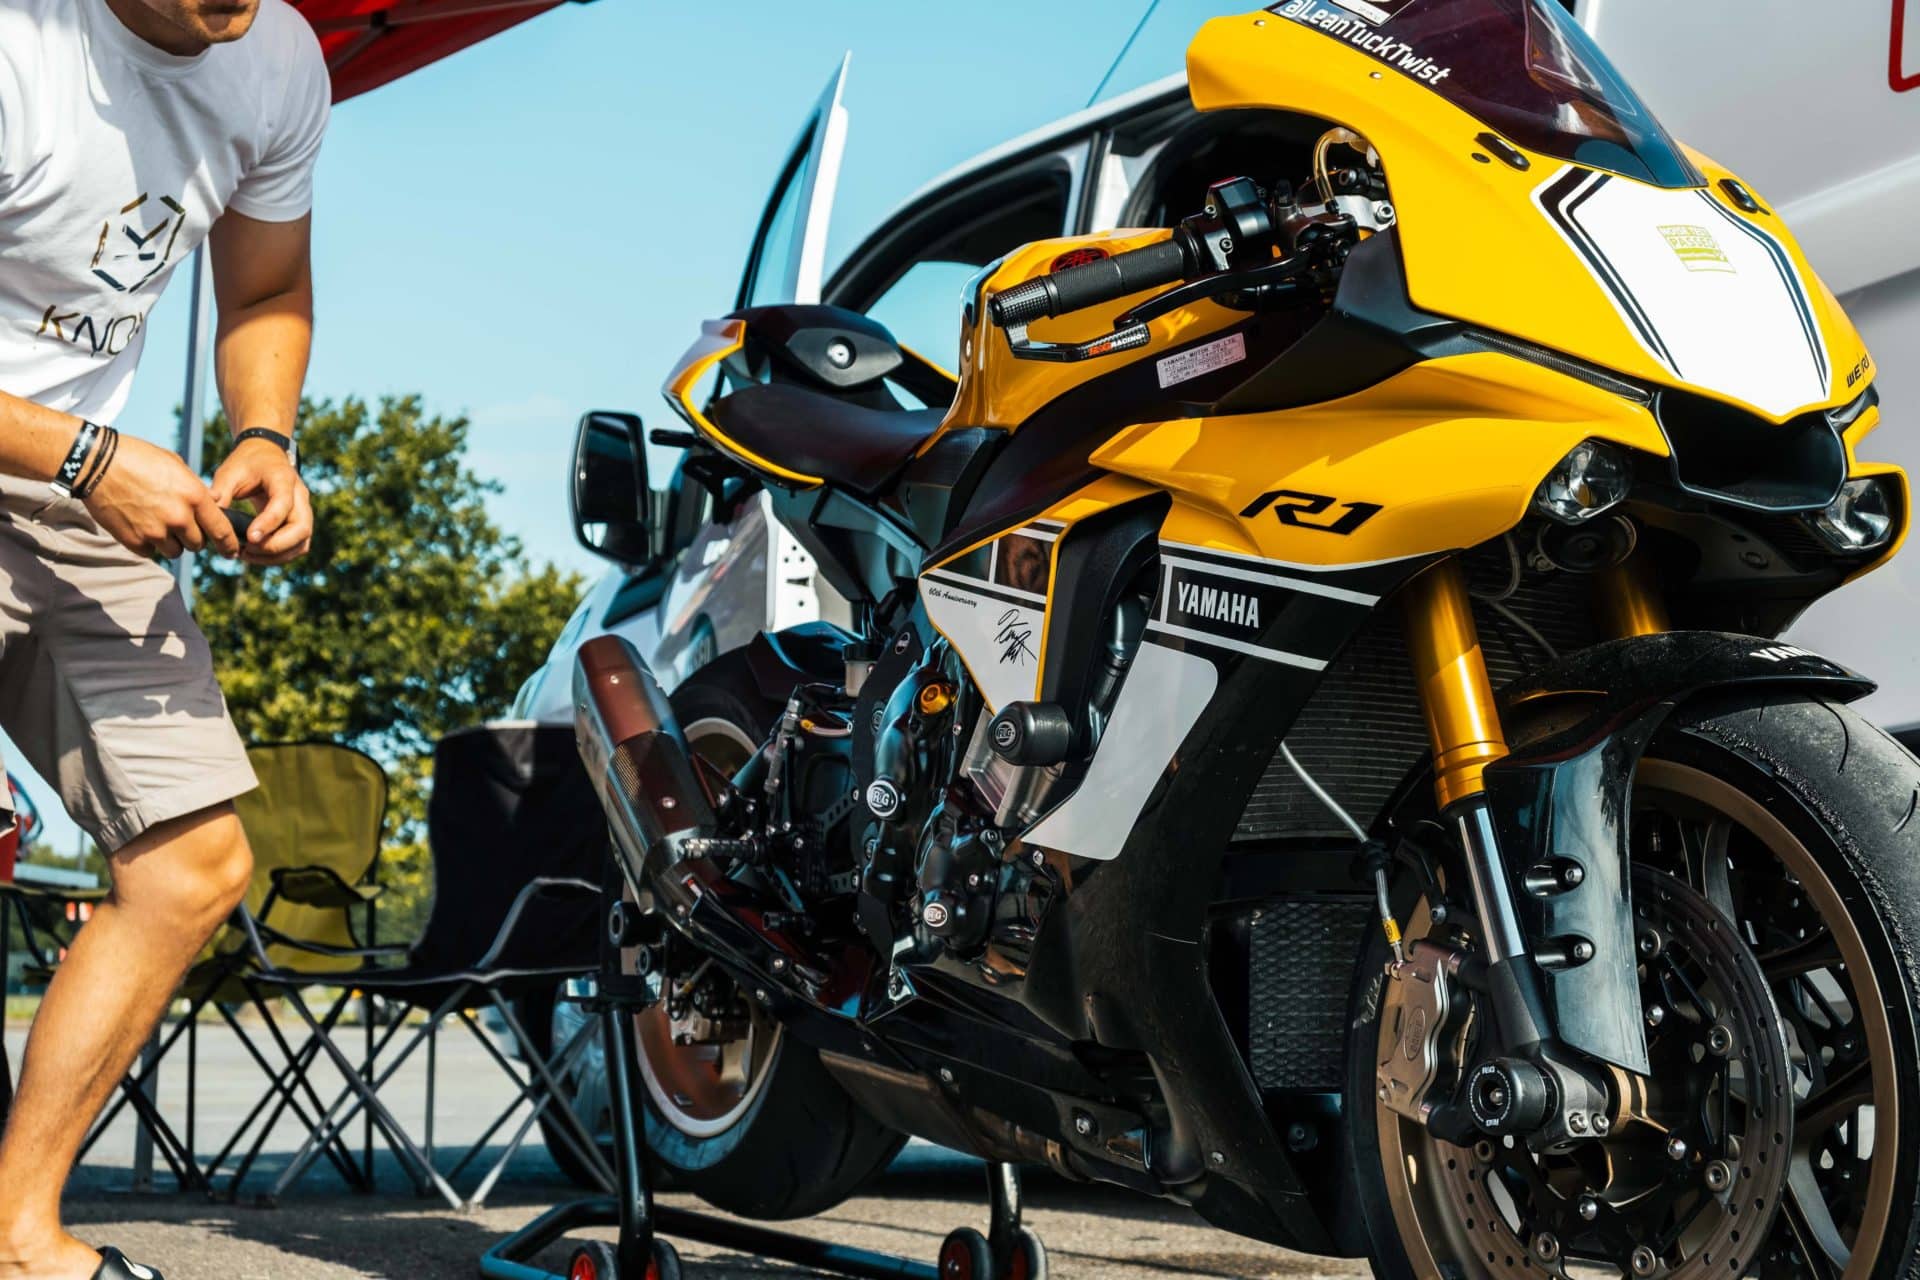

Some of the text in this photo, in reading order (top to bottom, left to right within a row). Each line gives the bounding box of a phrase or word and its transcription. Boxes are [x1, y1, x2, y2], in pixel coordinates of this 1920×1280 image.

[1239, 489, 1384, 536] R1
[942, 589, 978, 608] Anniversary
[1178, 581, 1260, 629] YAMAHA
